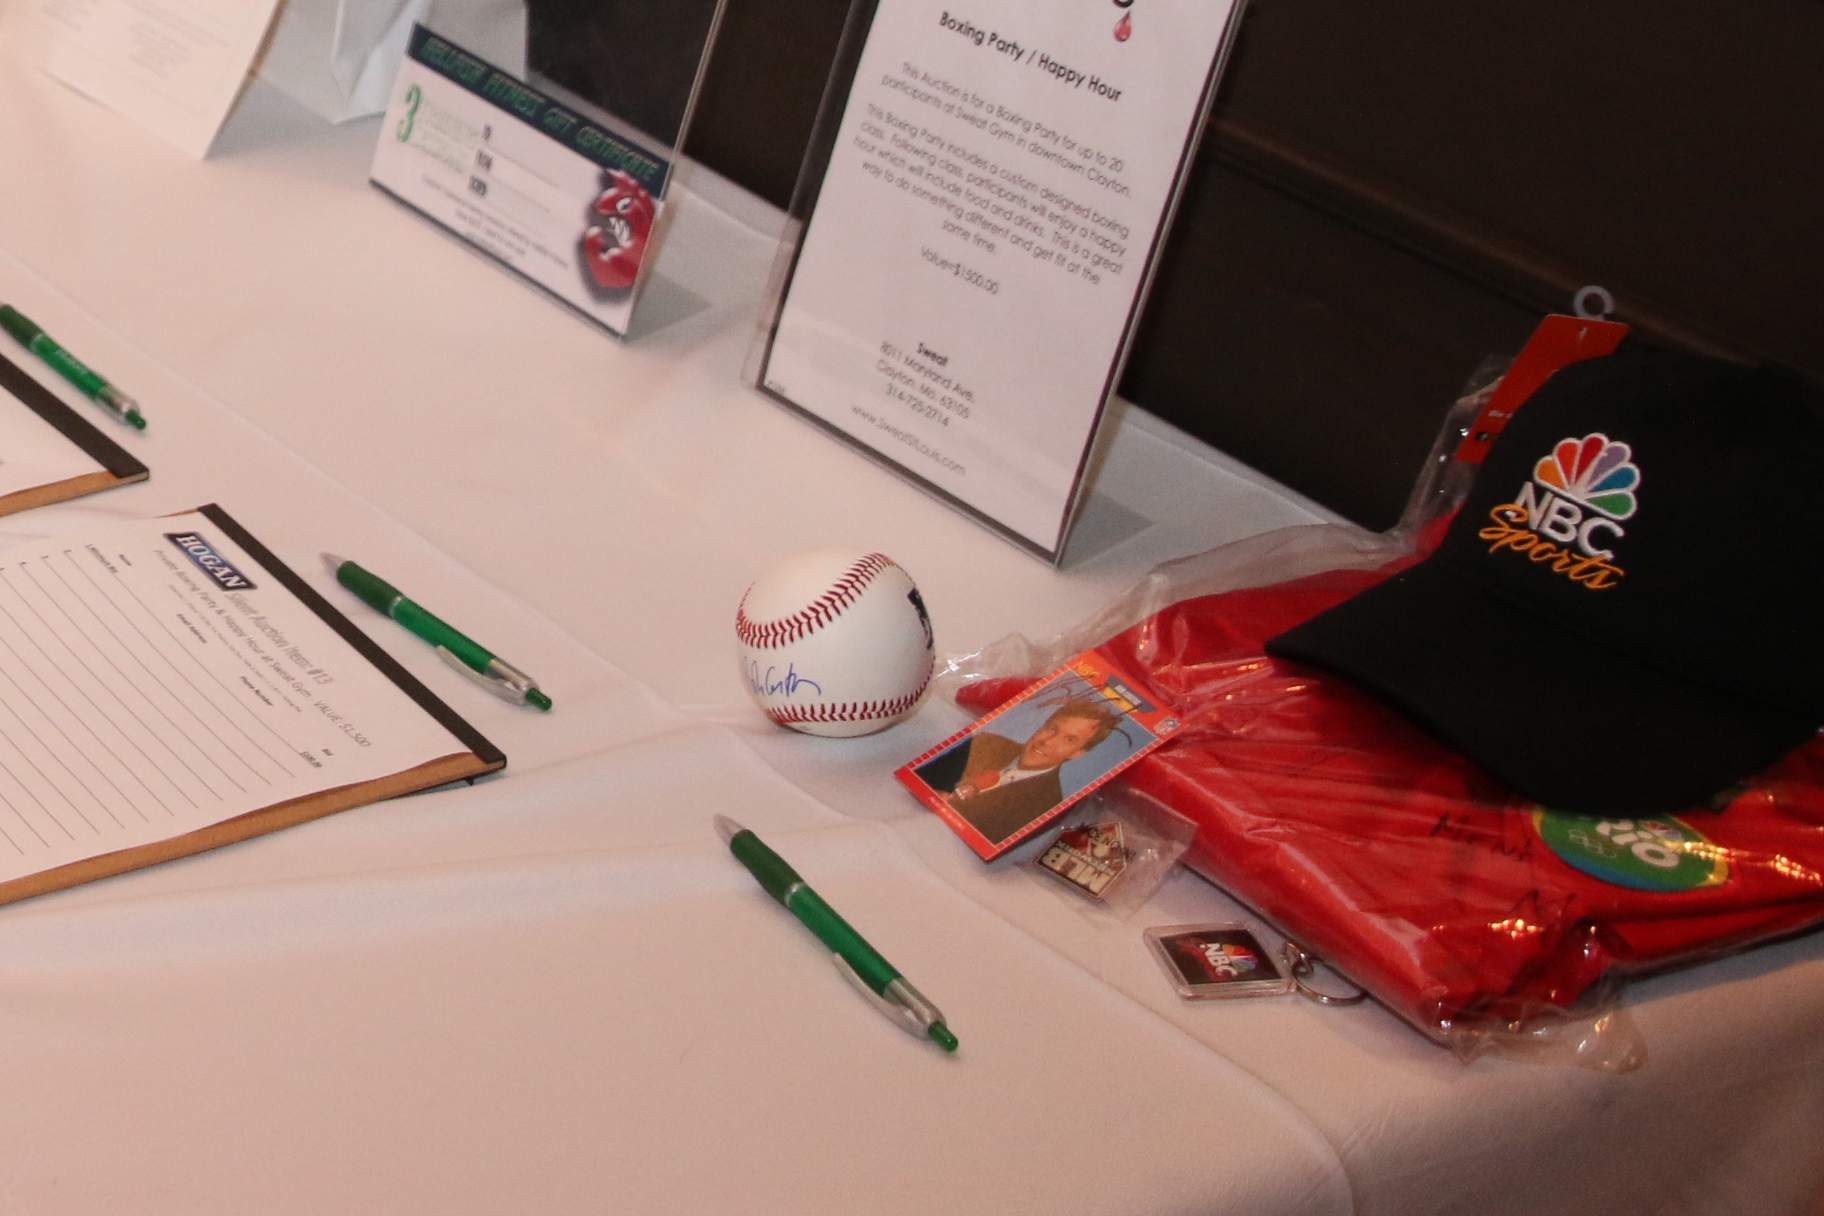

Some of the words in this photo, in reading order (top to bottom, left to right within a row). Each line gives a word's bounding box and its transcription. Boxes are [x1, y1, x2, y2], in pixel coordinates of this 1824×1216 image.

[939, 11, 985, 45] Boxing
[987, 31, 1024, 61] Party
[1037, 53, 1085, 87] Happy
[1087, 76, 1122, 101] Hour
[396, 84, 422, 143] 3
[916, 341, 948, 366] Sweat
[1479, 504, 1626, 589] Sports
[1505, 481, 1624, 561] NBC
[176, 535, 245, 587] HOGAN
[153, 549, 179, 570] Private
[174, 570, 201, 592] Boxing
[197, 591, 218, 609] Party
[222, 615, 246, 637] Happy
[244, 637, 265, 654] Hour
[260, 654, 274, 662] at
[268, 662, 296, 682] Sweat
[290, 681, 312, 698] Gym
[312, 700, 342, 722] VALUE:
[337, 722, 371, 747] $1,500
[223, 591, 258, 615] Silent
[249, 615, 289, 647] Auction
[282, 646, 313, 669] Item:
[306, 667, 333, 684] #13
[1040, 847, 1112, 893] MLB
[1200, 942, 1239, 977] NBC
